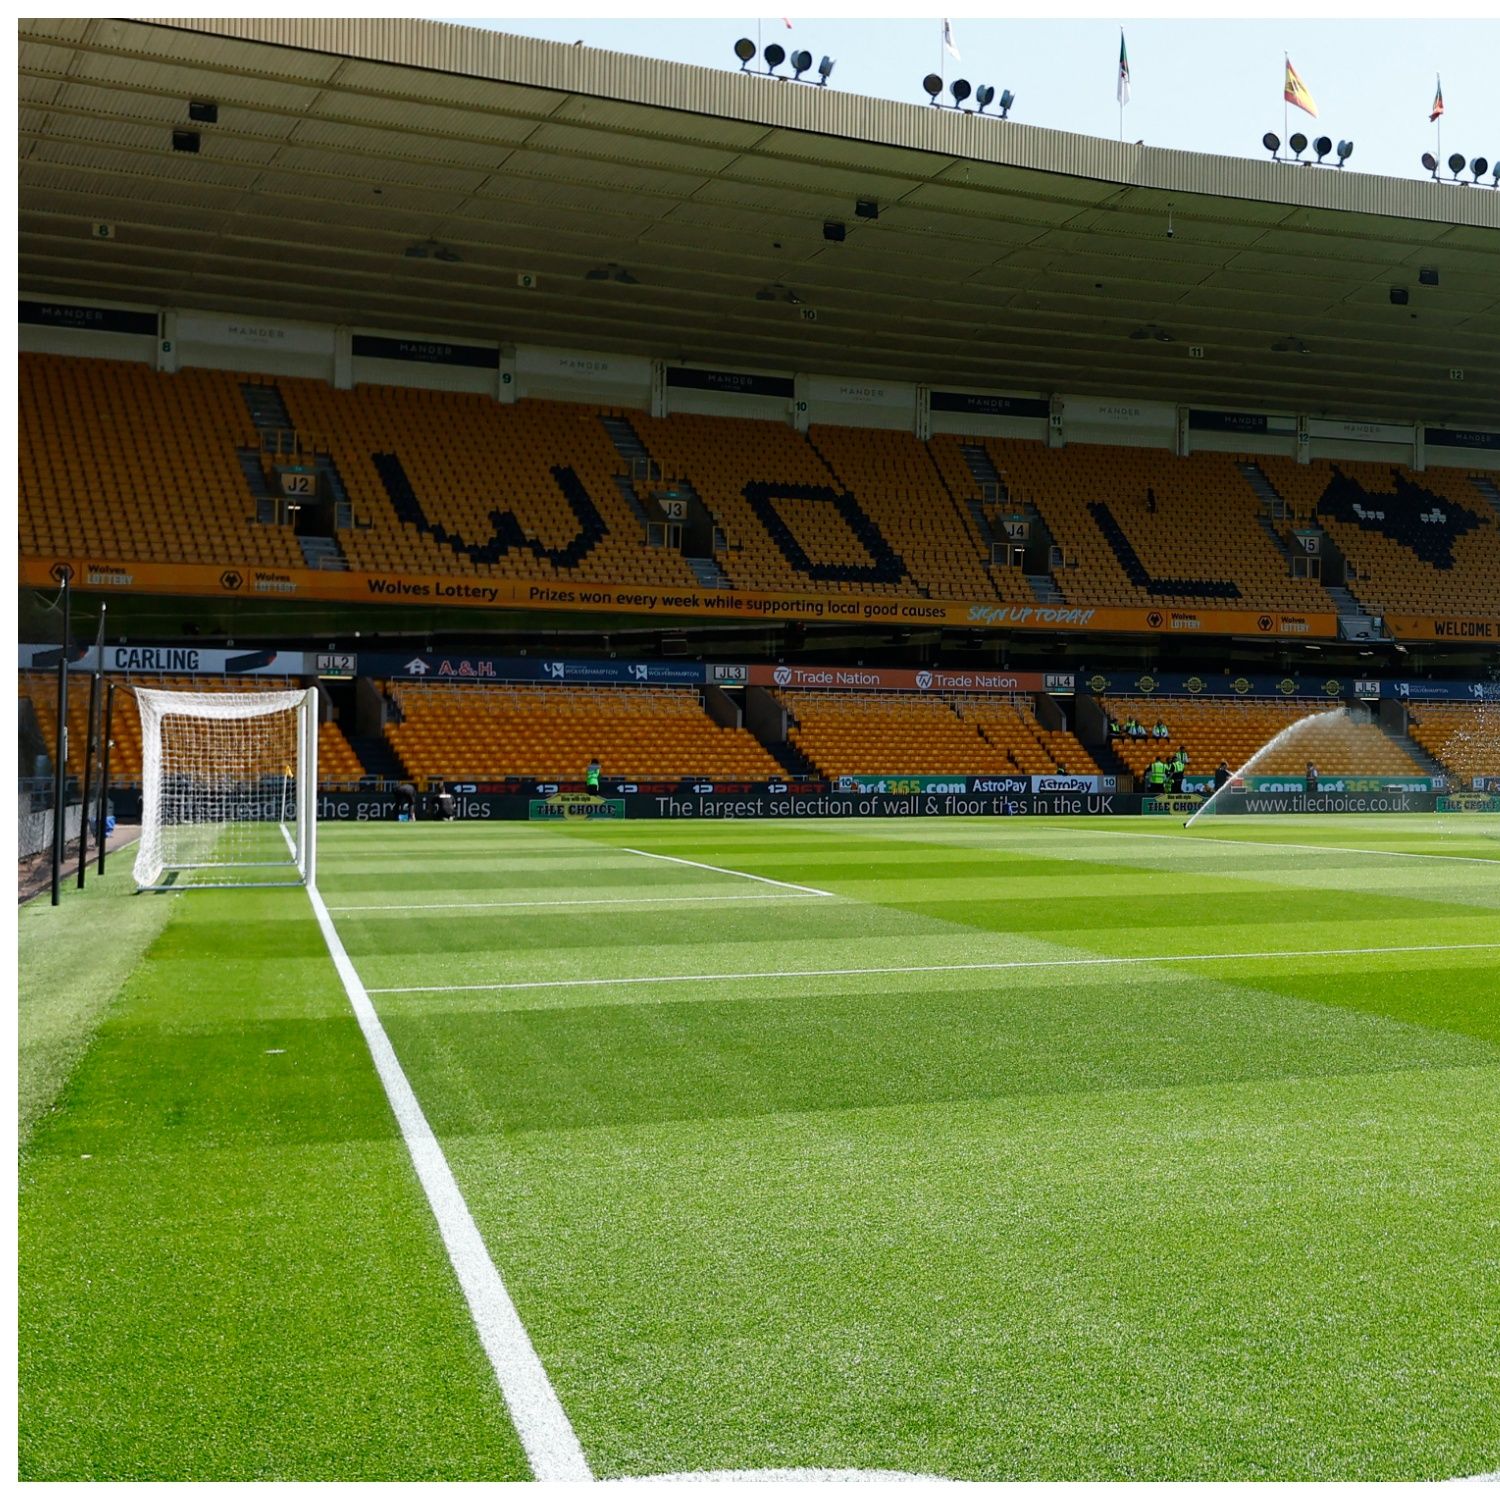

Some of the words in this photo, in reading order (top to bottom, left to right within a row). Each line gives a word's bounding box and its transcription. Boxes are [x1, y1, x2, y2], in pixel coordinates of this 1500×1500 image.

[42, 307, 103, 321] MANDER
[803, 310, 815, 320] 10
[228, 327, 285, 340] MANDER
[162, 341, 171, 353] 8
[400, 343, 451, 356] MANDER
[559, 359, 608, 371] MANDER
[502, 373, 511, 384] 9
[708, 374, 752, 386] MANDER
[840, 387, 884, 398] MANDER
[796, 401, 807, 412] 10
[967, 398, 1010, 408] MANDER
[1099, 407, 1140, 417] MANDER
[1052, 416, 1061, 425] 11
[1225, 416, 1264, 427] MANDER
[1343, 425, 1380, 435] MANDER
[1456, 433, 1491, 444] MANDER
[288, 476, 308, 492] J2
[667, 502, 682, 518] J3
[1008, 524, 1025, 537] J4
[88, 564, 127, 575] Wolves
[254, 571, 290, 582] Wolves
[368, 579, 430, 596] Wolves
[435, 582, 498, 602] Lottery
[529, 586, 575, 602] Prizes
[579, 590, 611, 604] won
[616, 592, 657, 609] every
[662, 593, 700, 608] week
[704, 594, 743, 609] while
[746, 597, 823, 615] supporting
[828, 600, 860, 614] local
[864, 602, 897, 617] good
[902, 606, 946, 618] causes
[967, 606, 1008, 623] SIGN
[1010, 608, 1033, 623] UP
[1170, 612, 1196, 622] Wolves
[1434, 620, 1491, 637] WELCOME
[115, 648, 199, 670] CARLING
[565, 668, 618, 676] WOLVERHAMPTON
[649, 669, 699, 678] WOLVERHAMPTON
[720, 667, 741, 679] JL3
[794, 671, 833, 683] Trade
[836, 672, 880, 684] Nation
[935, 674, 972, 686] Trade
[975, 675, 1017, 688] Nation
[1049, 675, 1071, 686] JL4
[1357, 681, 1377, 692] JL5
[840, 779, 850, 787] 10
[972, 779, 1026, 793] AstroPay
[1104, 778, 1115, 787] 10
[316, 796, 350, 817] the
[656, 796, 694, 816] The
[700, 796, 764, 819] largest
[770, 796, 852, 815] selection
[859, 796, 878, 814] of
[882, 796, 918, 814] wall
[926, 796, 940, 814] &
[945, 796, 987, 814] floor
[993, 796, 1027, 813] tiles
[1033, 796, 1047, 813] in
[1053, 796, 1081, 813] the
[1086, 795, 1114, 813] UK
[1246, 794, 1410, 812] www.tilechoice.co.uk
[537, 805, 564, 815] TILE
[568, 804, 616, 815] CHOICE
